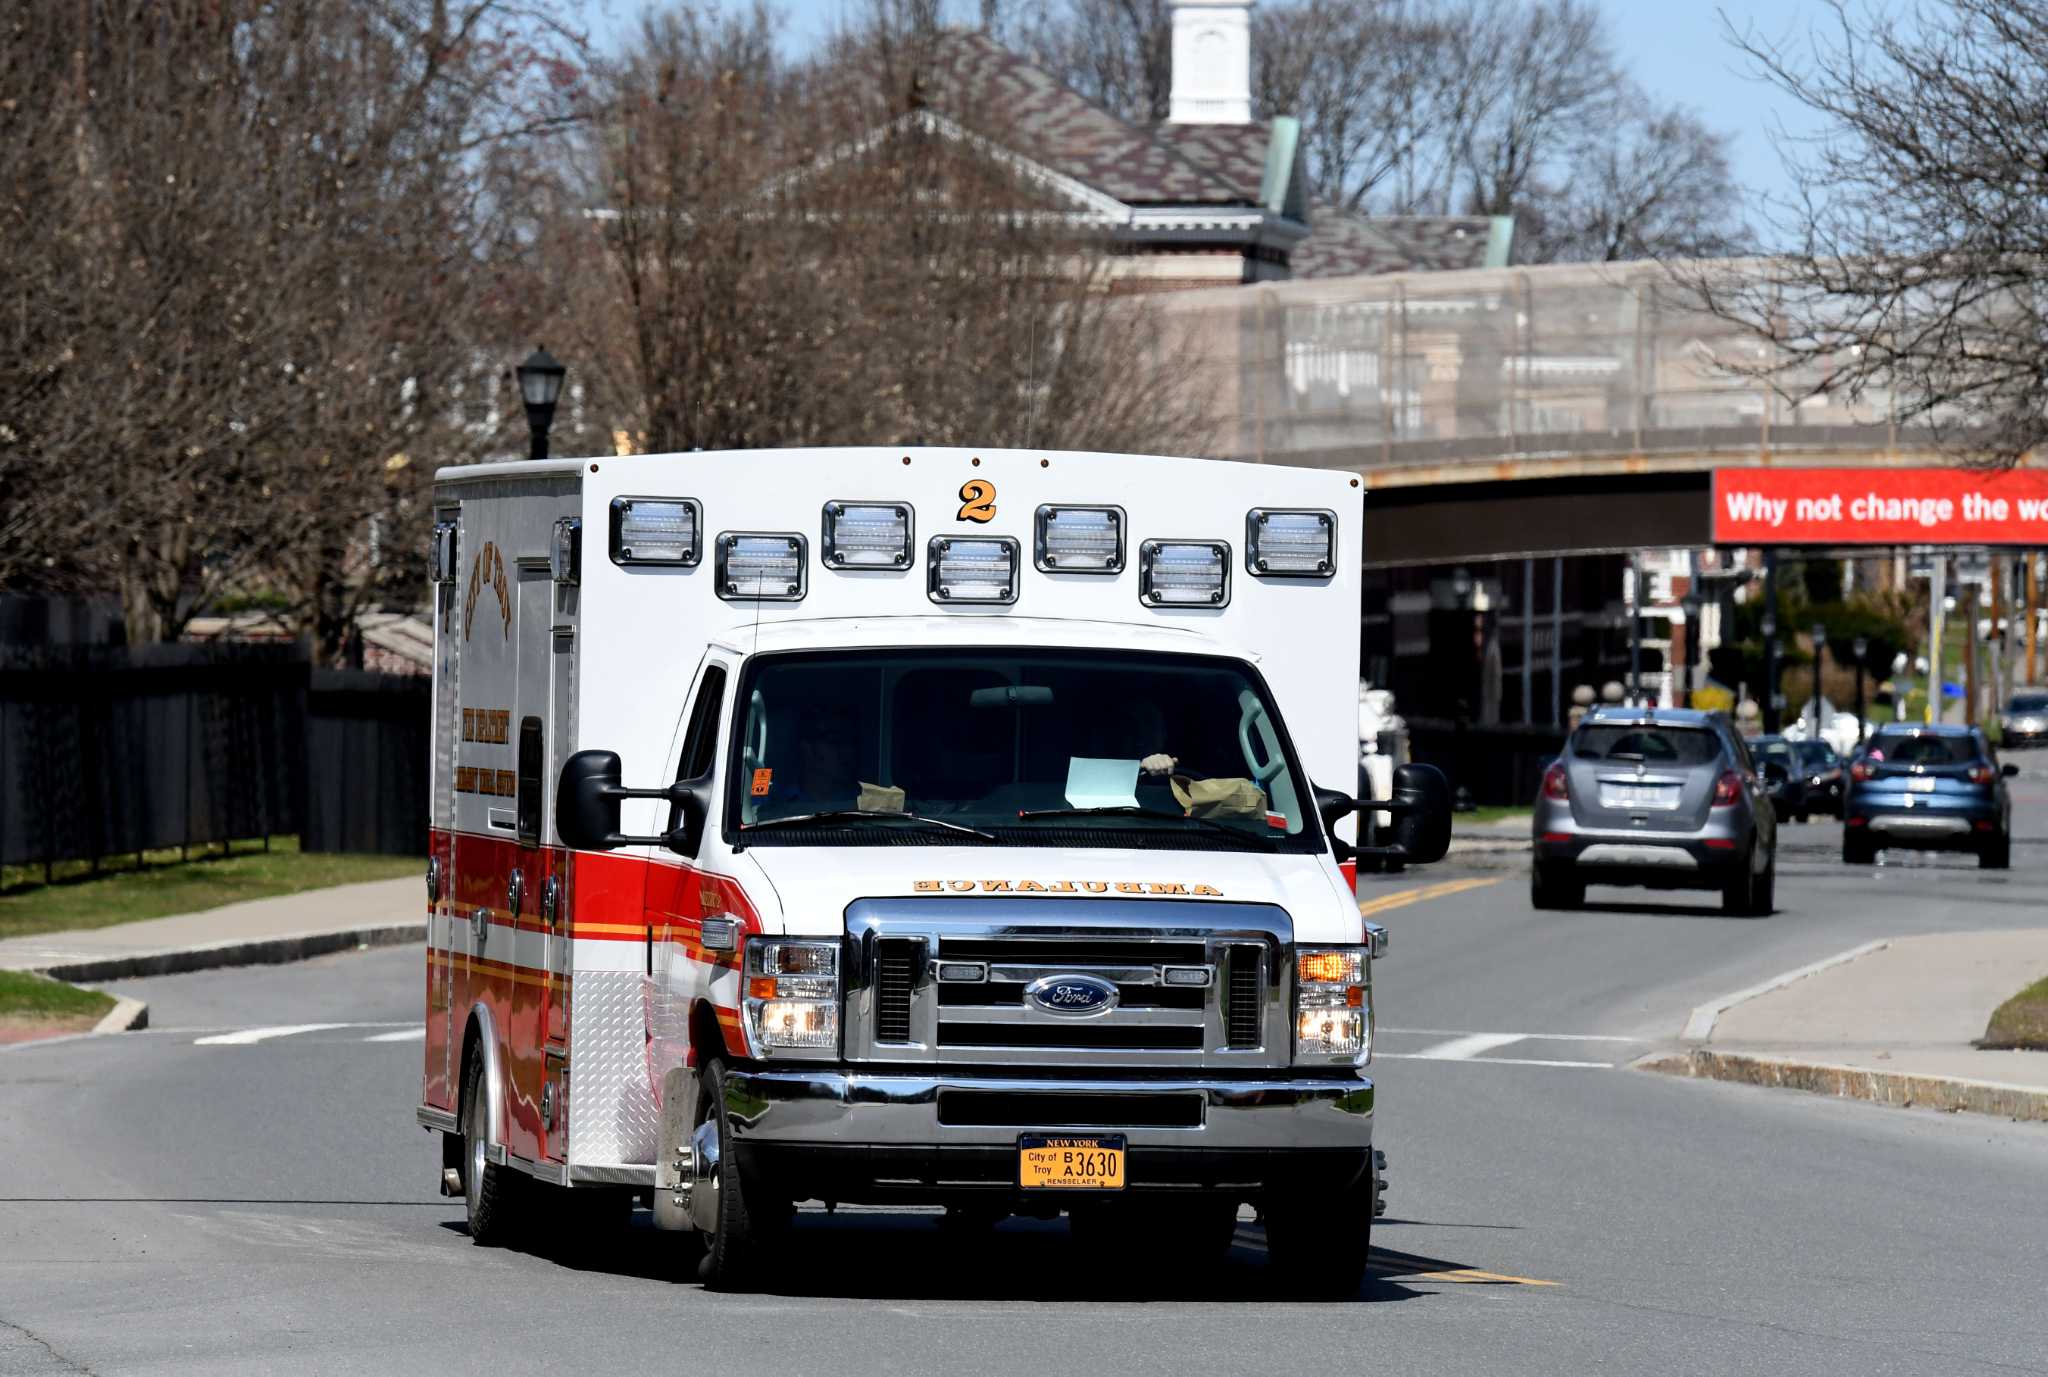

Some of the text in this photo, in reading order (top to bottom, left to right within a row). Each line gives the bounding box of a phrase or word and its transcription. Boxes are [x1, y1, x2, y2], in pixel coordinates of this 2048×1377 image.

[956, 479, 997, 524] 2
[1726, 491, 1788, 527] Why
[1795, 493, 1843, 521] not
[1849, 492, 1953, 527] change
[1962, 492, 2010, 521] the
[1051, 985, 1094, 1004] Ford
[1046, 1139, 1099, 1149] NEW YORK
[1028, 1152, 1057, 1163] City of
[1075, 1152, 1117, 1177] 3630
[1033, 1165, 1052, 1176] Troy
